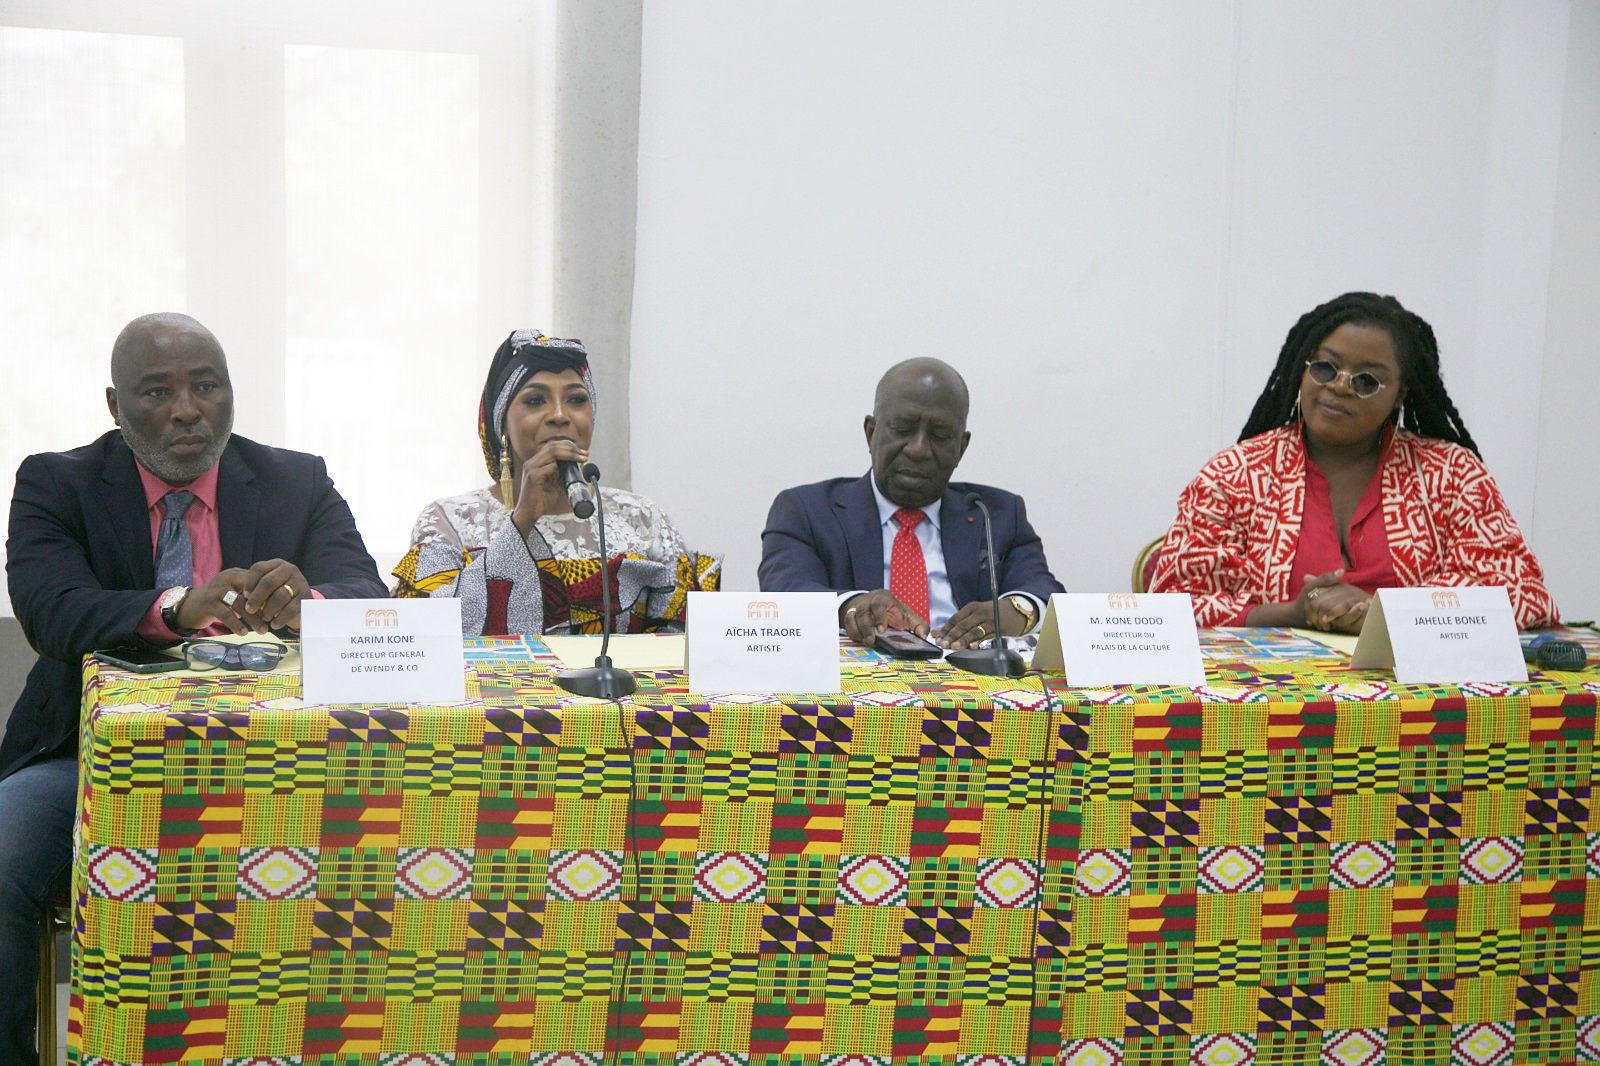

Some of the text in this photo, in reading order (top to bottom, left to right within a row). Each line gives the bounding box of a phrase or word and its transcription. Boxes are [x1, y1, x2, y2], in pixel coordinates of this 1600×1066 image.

[1090, 617, 1164, 625] M. KONE DODO
[1414, 616, 1487, 626] JAHELLE BONEE
[725, 626, 802, 636] AÏCHA TRAORE
[350, 635, 415, 644] KARIM KONE
[1440, 632, 1470, 640] ARTISTE
[746, 644, 781, 652] ARTISTE
[340, 650, 426, 660] DIRECTEUR GENERAL
